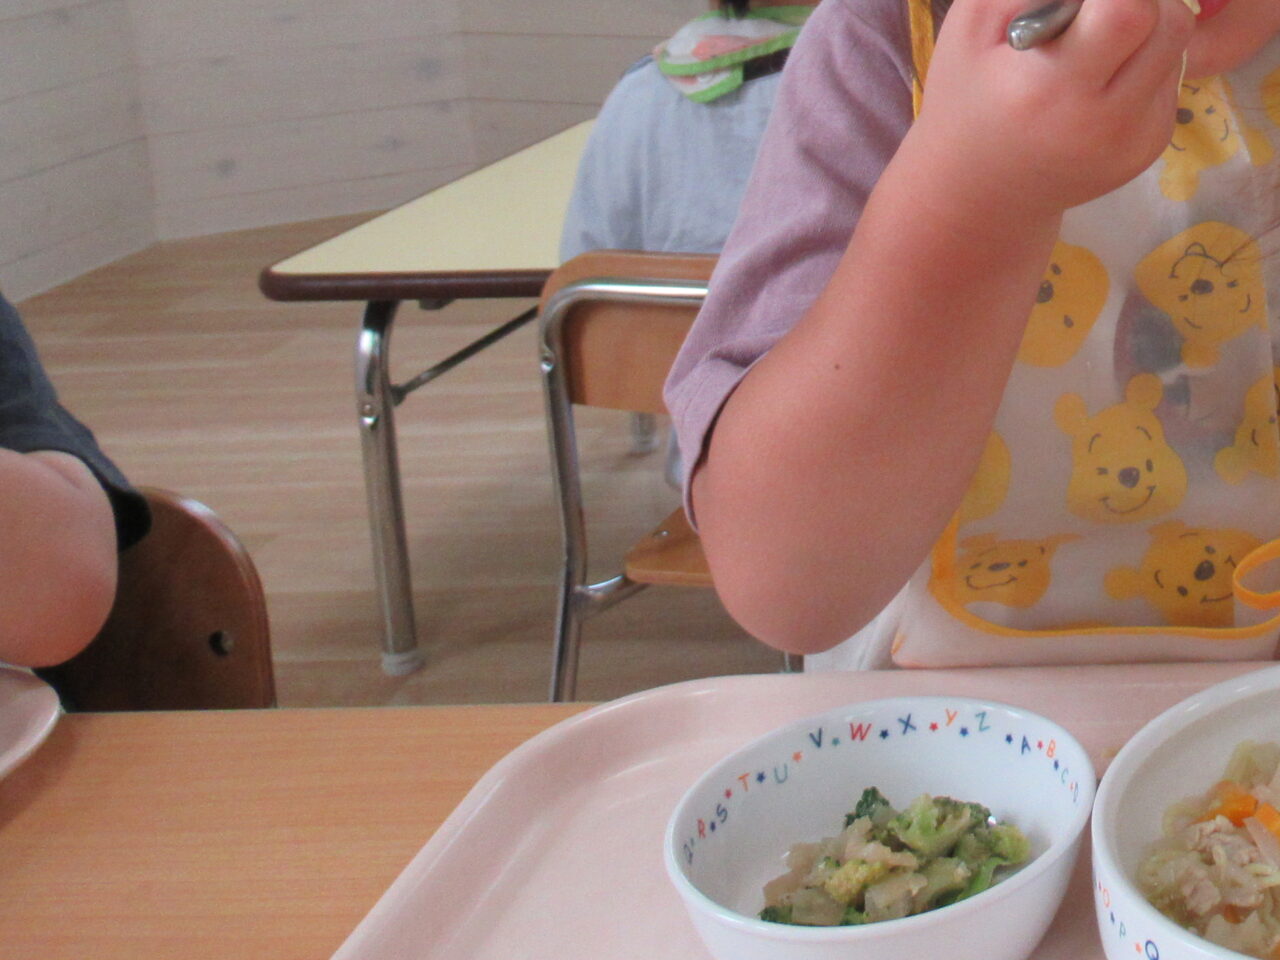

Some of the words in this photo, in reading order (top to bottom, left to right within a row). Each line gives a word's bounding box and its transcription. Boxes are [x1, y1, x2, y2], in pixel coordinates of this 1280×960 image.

[716, 803, 728, 824] S
[738, 772, 751, 792] T
[774, 763, 788, 784] U
[809, 727, 823, 748] V
[849, 722, 872, 742] W
[898, 713, 917, 736] X
[975, 711, 991, 732] Z
[1021, 735, 1031, 755] A
[1046, 739, 1056, 758] B
